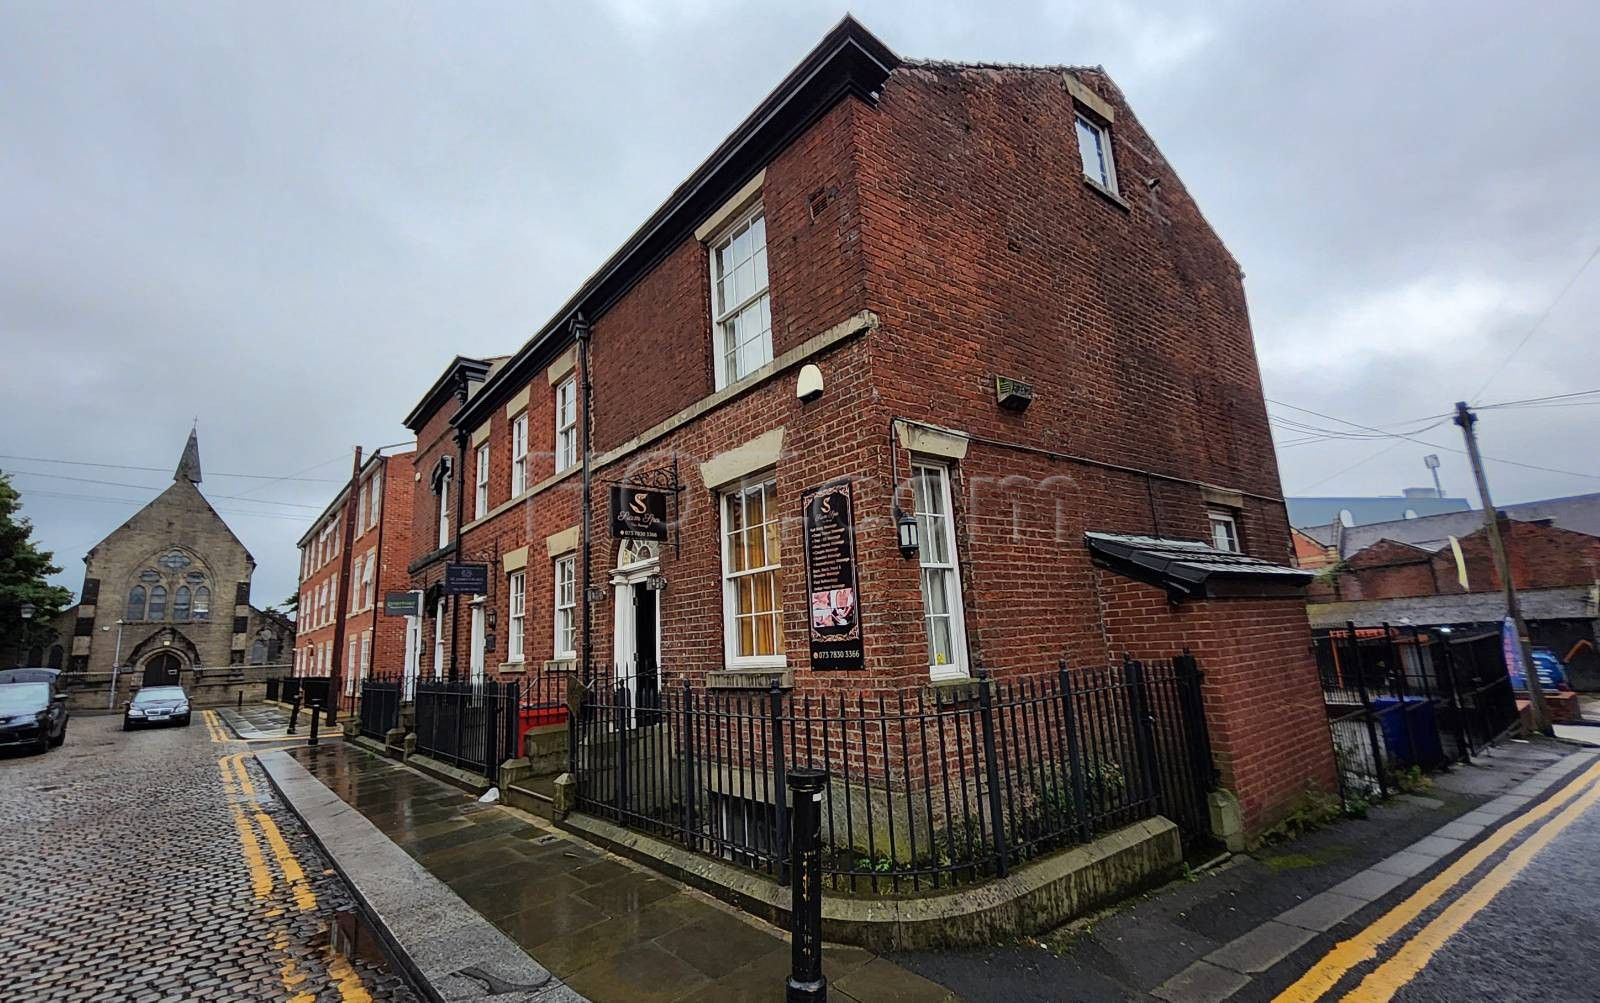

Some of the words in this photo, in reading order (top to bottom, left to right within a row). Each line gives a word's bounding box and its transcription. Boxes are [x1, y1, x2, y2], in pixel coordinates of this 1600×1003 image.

[819, 651, 829, 659] 073
[830, 651, 844, 659] 7830
[844, 650, 860, 658] 3366
